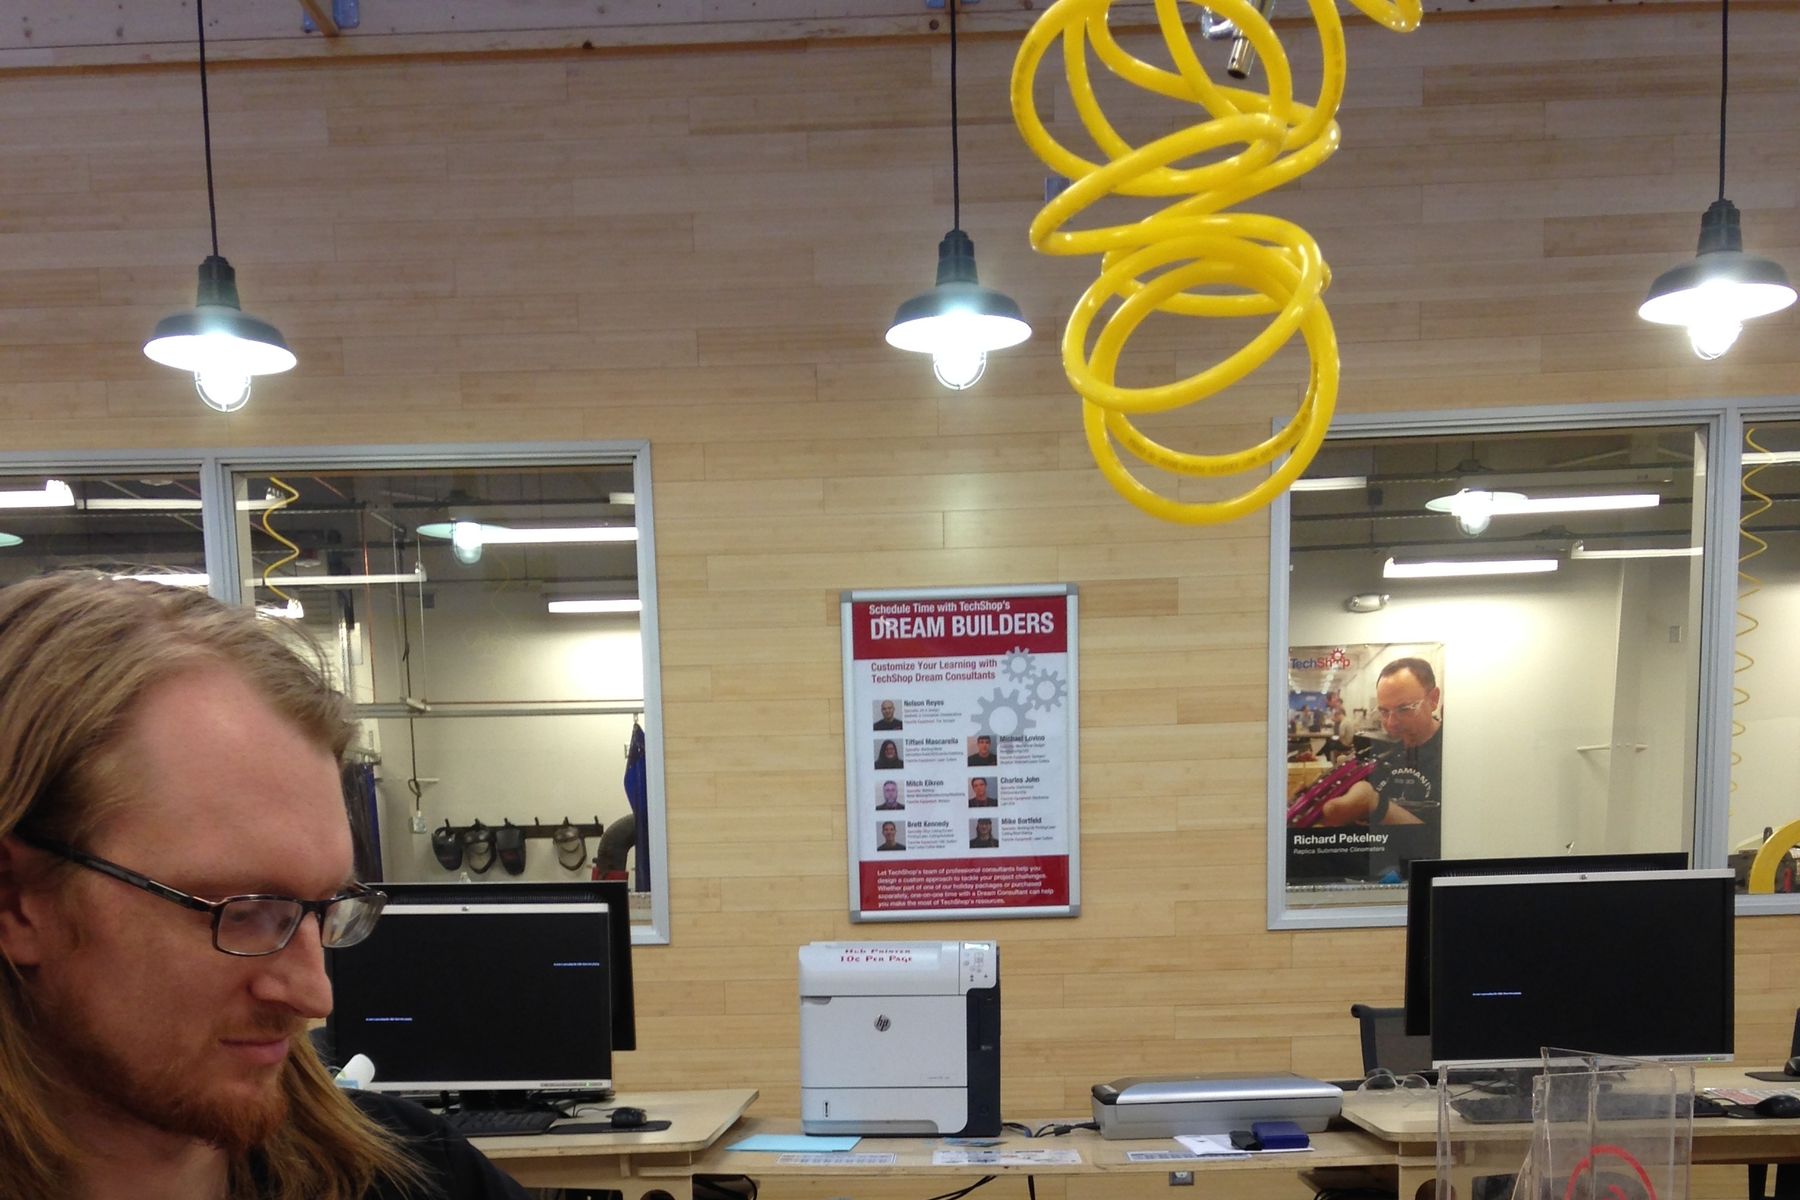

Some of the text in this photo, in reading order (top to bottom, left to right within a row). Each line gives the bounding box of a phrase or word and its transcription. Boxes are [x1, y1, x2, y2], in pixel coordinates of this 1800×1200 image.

[869, 600, 1010, 614] Schedule Time with TechShop's
[870, 612, 1054, 640] DREAM BUILDERS
[871, 658, 997, 672] Customize Your Learning with
[872, 670, 996, 684] TechShop Dream Consultants
[1294, 833, 1388, 844] Richard Pekelney
[876, 1014, 890, 1032] hp
